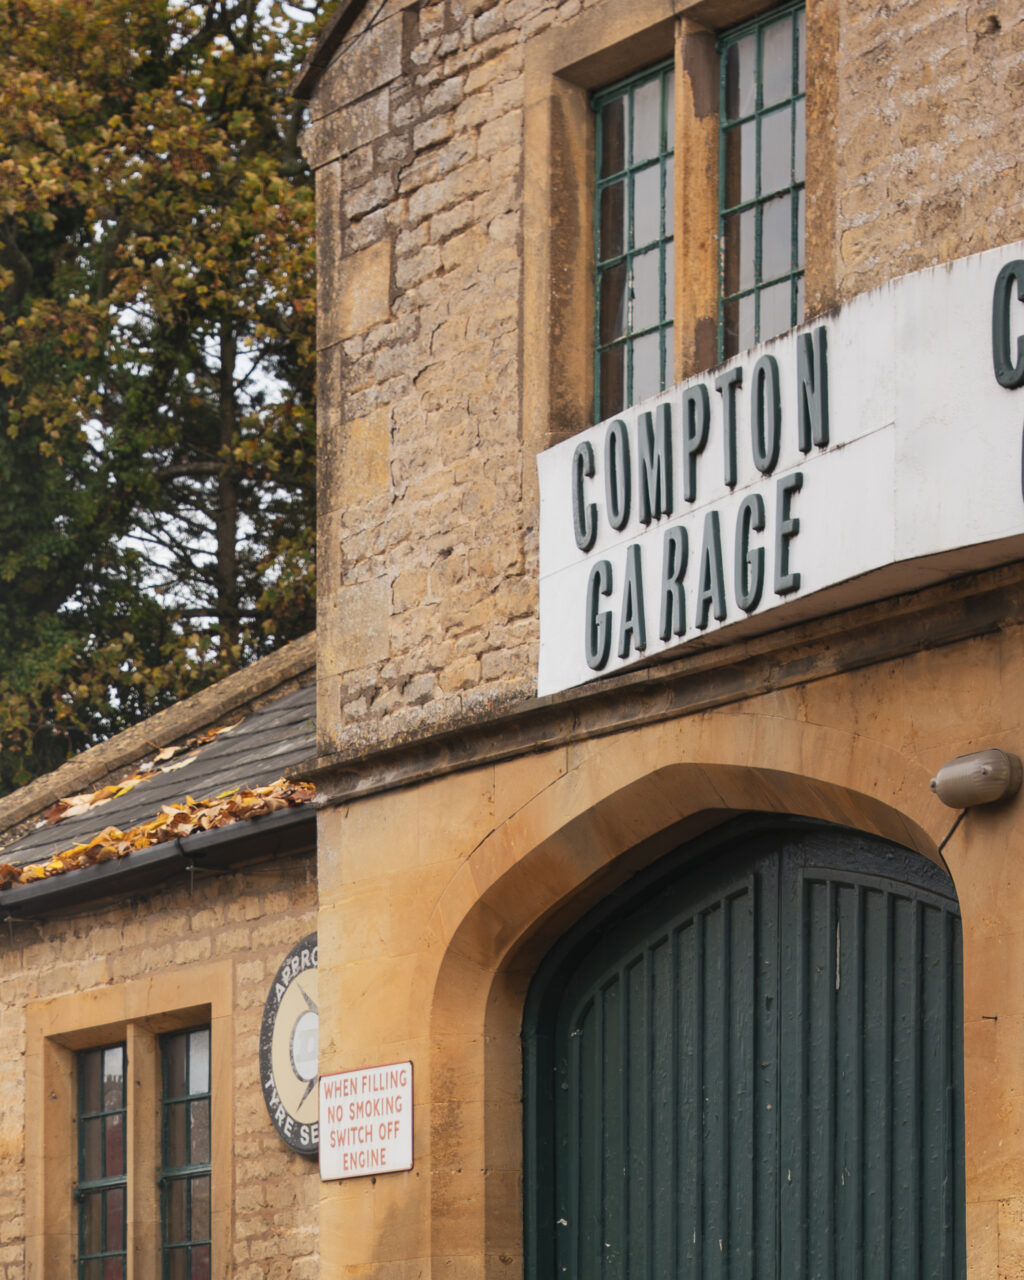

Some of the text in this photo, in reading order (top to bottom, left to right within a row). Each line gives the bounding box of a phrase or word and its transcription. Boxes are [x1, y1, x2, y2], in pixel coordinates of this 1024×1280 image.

[572, 325, 829, 552] COMPTON
[585, 472, 803, 671] GARAGE
[324, 1069, 407, 1100] WHEN FILLING
[265, 1073, 294, 1137] TYRE
[327, 1095, 402, 1123] NO SMOKING
[330, 1120, 400, 1148] SWITCH OFF
[343, 1147, 387, 1171] ENGINE
